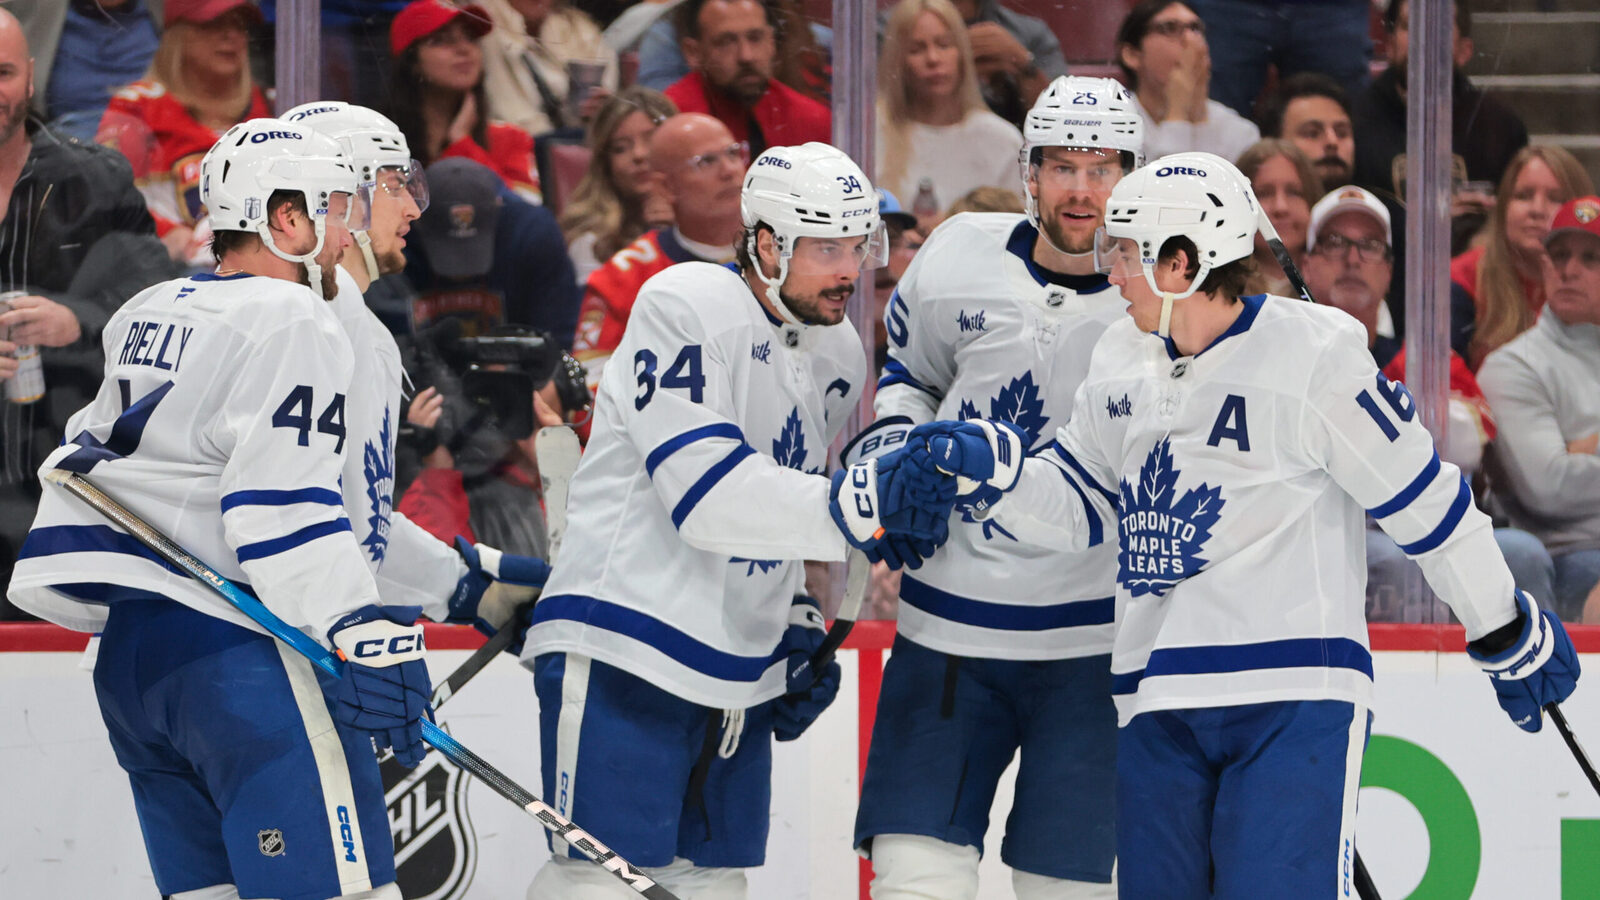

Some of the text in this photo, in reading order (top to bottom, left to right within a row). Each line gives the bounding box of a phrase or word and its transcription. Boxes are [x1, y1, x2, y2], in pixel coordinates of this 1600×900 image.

[289, 106, 340, 121] OREO
[1072, 92, 1098, 106] 25
[250, 131, 303, 144] OREO
[1063, 119, 1102, 128] BAUER
[757, 156, 792, 170] OREO
[1155, 166, 1208, 178] OREO
[836, 176, 862, 194] 34
[841, 207, 872, 218] CCM
[886, 286, 911, 349] 5
[118, 321, 194, 373] RIELLY
[634, 344, 706, 412] 34
[272, 384, 347, 455] 44
[1355, 369, 1416, 443] 16
[1206, 393, 1251, 452] A
[852, 461, 875, 519] CC
[1121, 510, 1197, 542] TORONTO
[1128, 535, 1182, 556] MAPLE
[1128, 554, 1184, 575] LEAFS
[387, 780, 442, 845] HL
[336, 805, 358, 863] CCM
[524, 800, 656, 893] CCM
